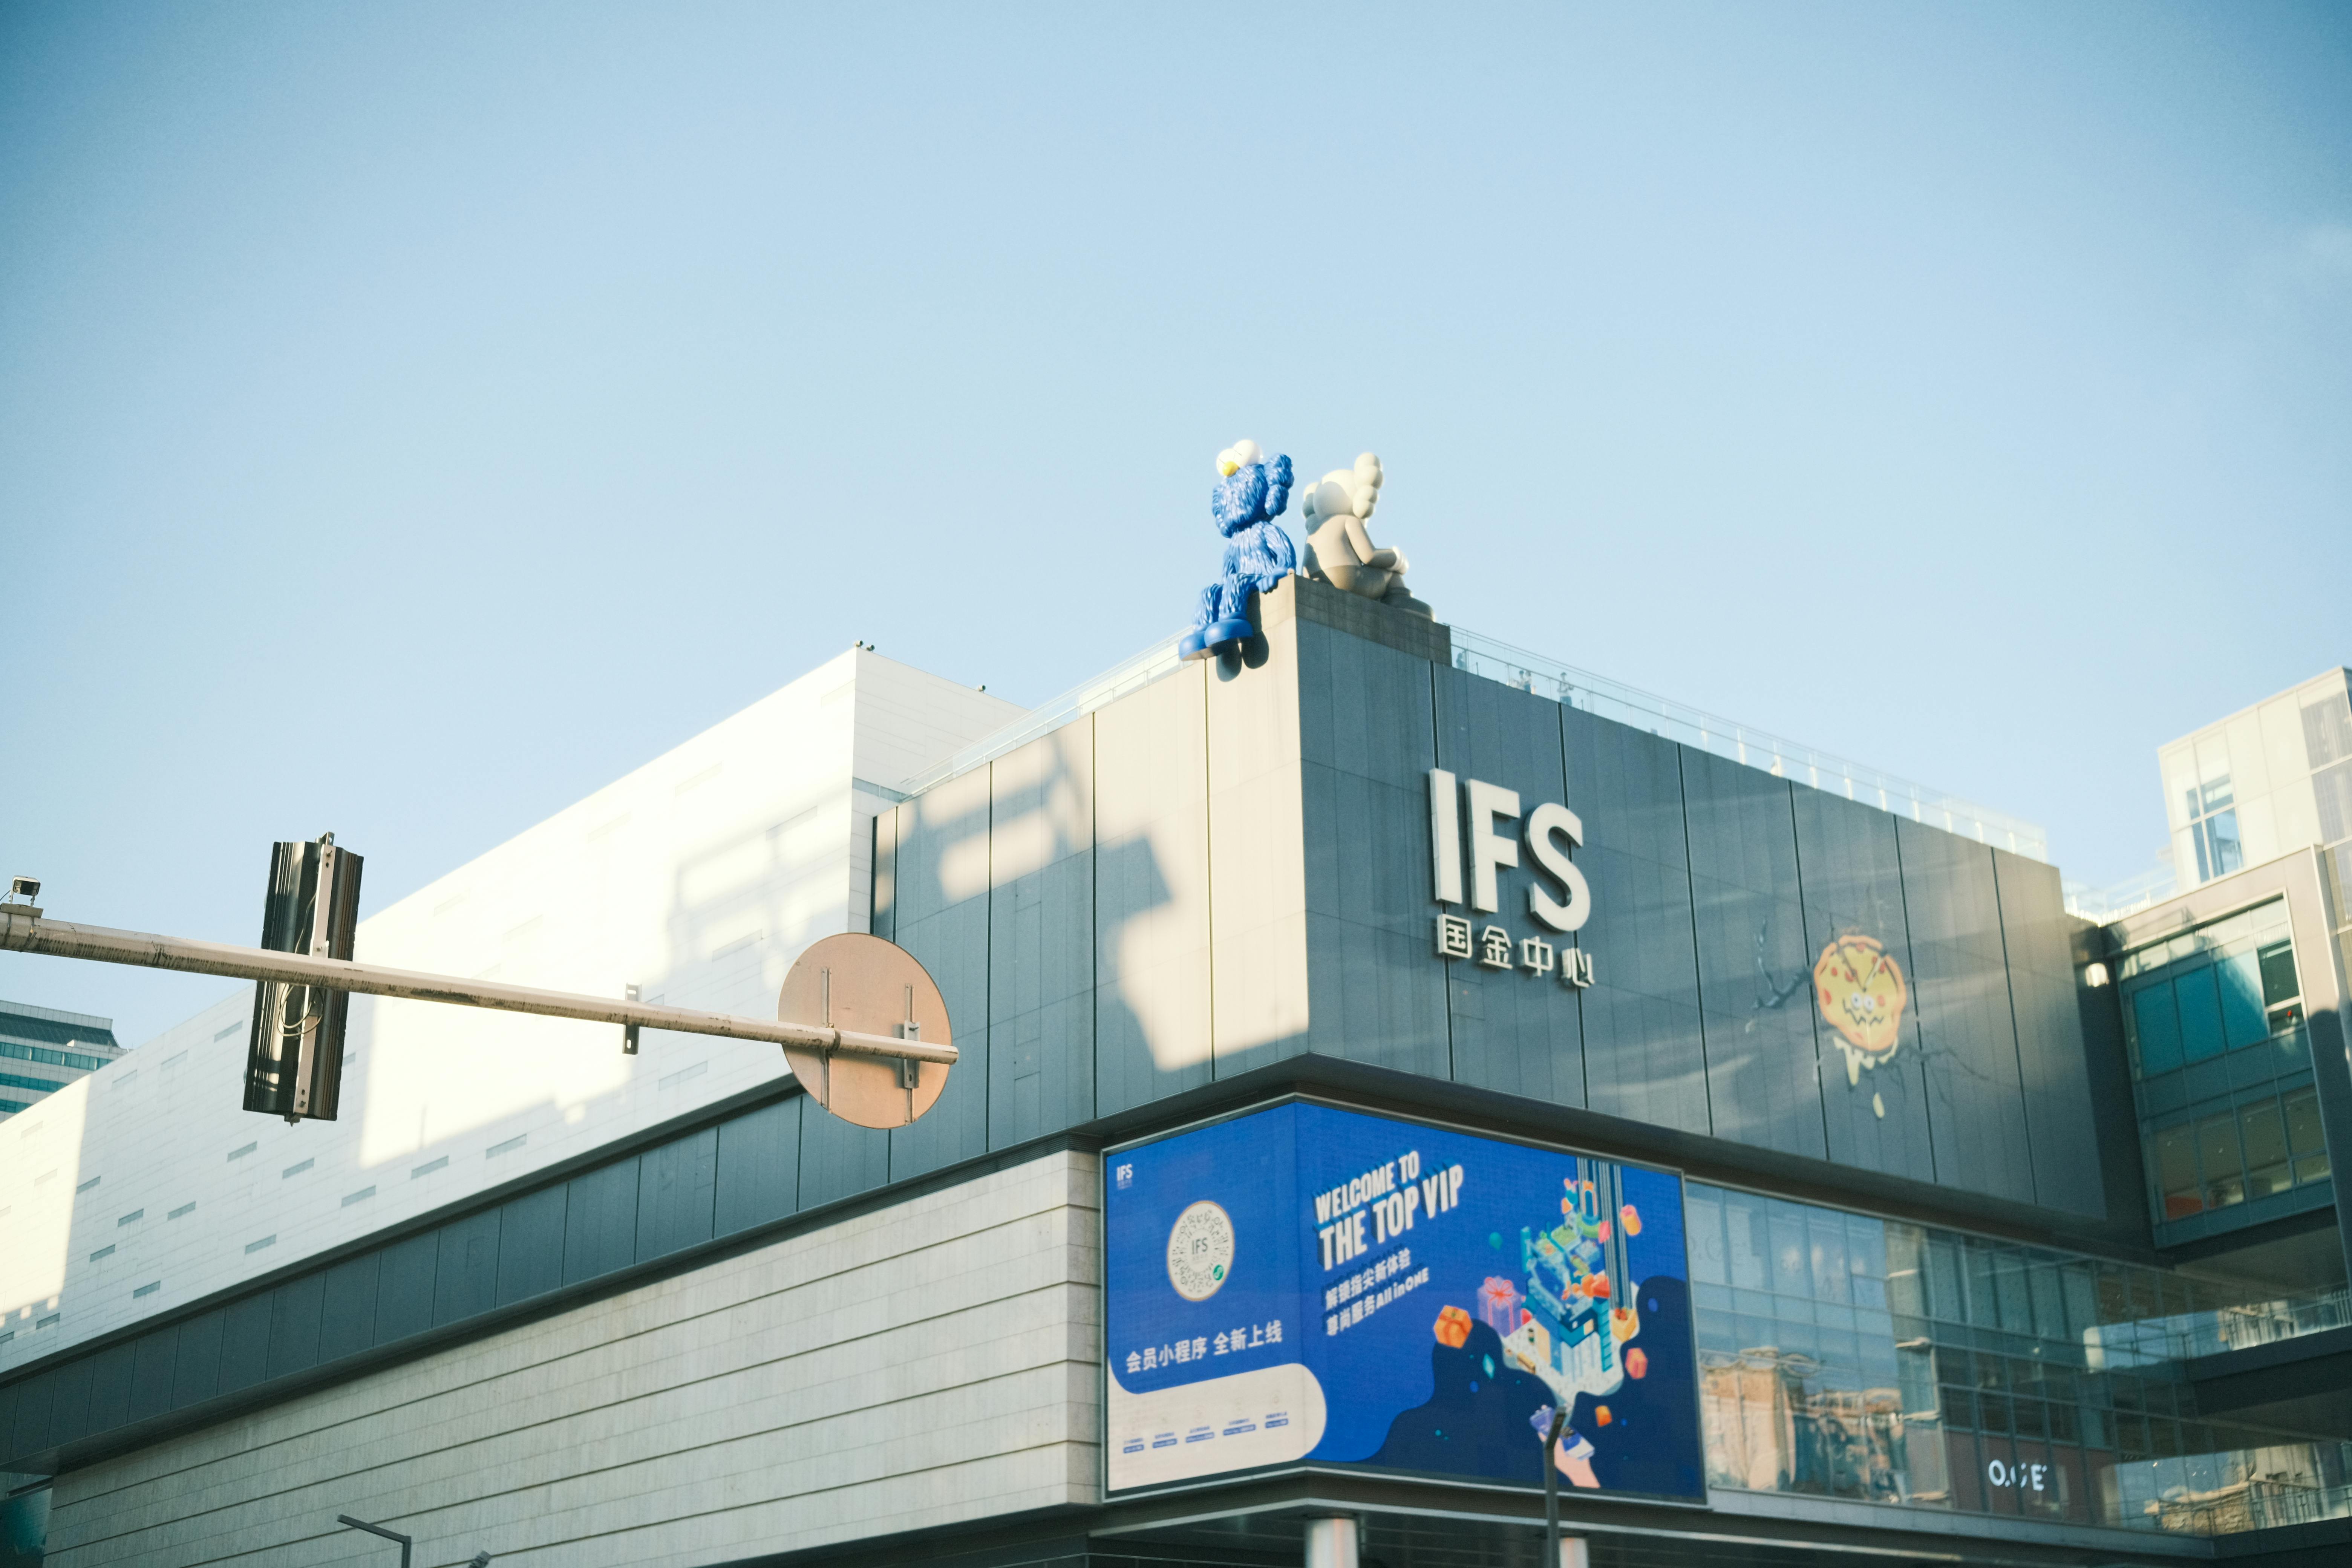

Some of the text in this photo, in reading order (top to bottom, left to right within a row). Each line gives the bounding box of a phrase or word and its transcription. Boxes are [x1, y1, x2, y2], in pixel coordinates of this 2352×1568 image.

[1429, 768, 1591, 931] IFS
[1437, 914, 1595, 988] 国金中心
[1117, 1164, 1133, 1181] IFS
[1315, 1151, 1419, 1223] WELCOME TO
[1192, 1237, 1208, 1255] IFS
[1319, 1164, 1463, 1271] THE TOP VIP
[1326, 1247, 1410, 1311] 解锁指尖新体验
[1126, 1320, 1282, 1373] 会员小程序 全新上线
